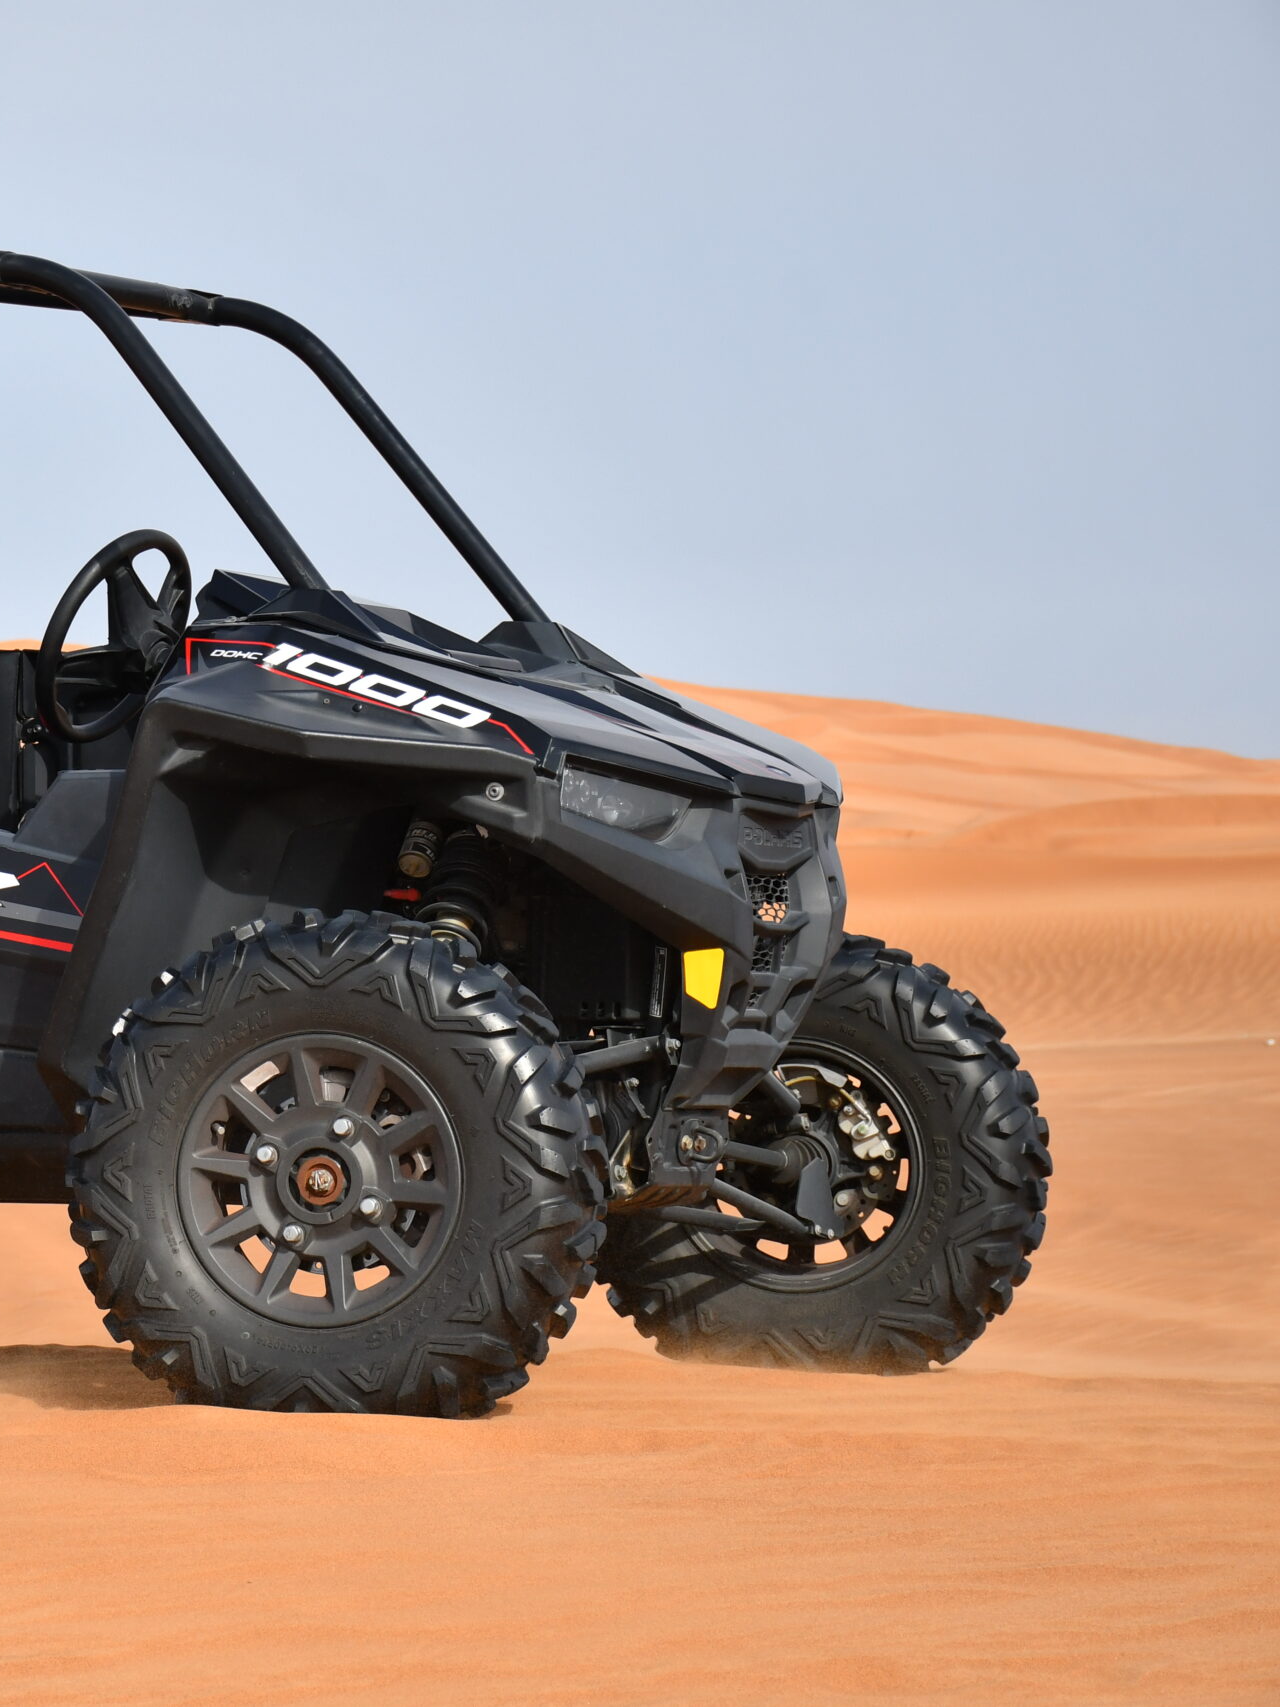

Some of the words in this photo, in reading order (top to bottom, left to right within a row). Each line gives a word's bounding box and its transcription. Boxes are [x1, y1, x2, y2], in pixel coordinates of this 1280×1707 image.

[210, 648, 263, 661] DOHC
[262, 642, 491, 728] 1000
[886, 1136, 952, 1286] BIGHORN
